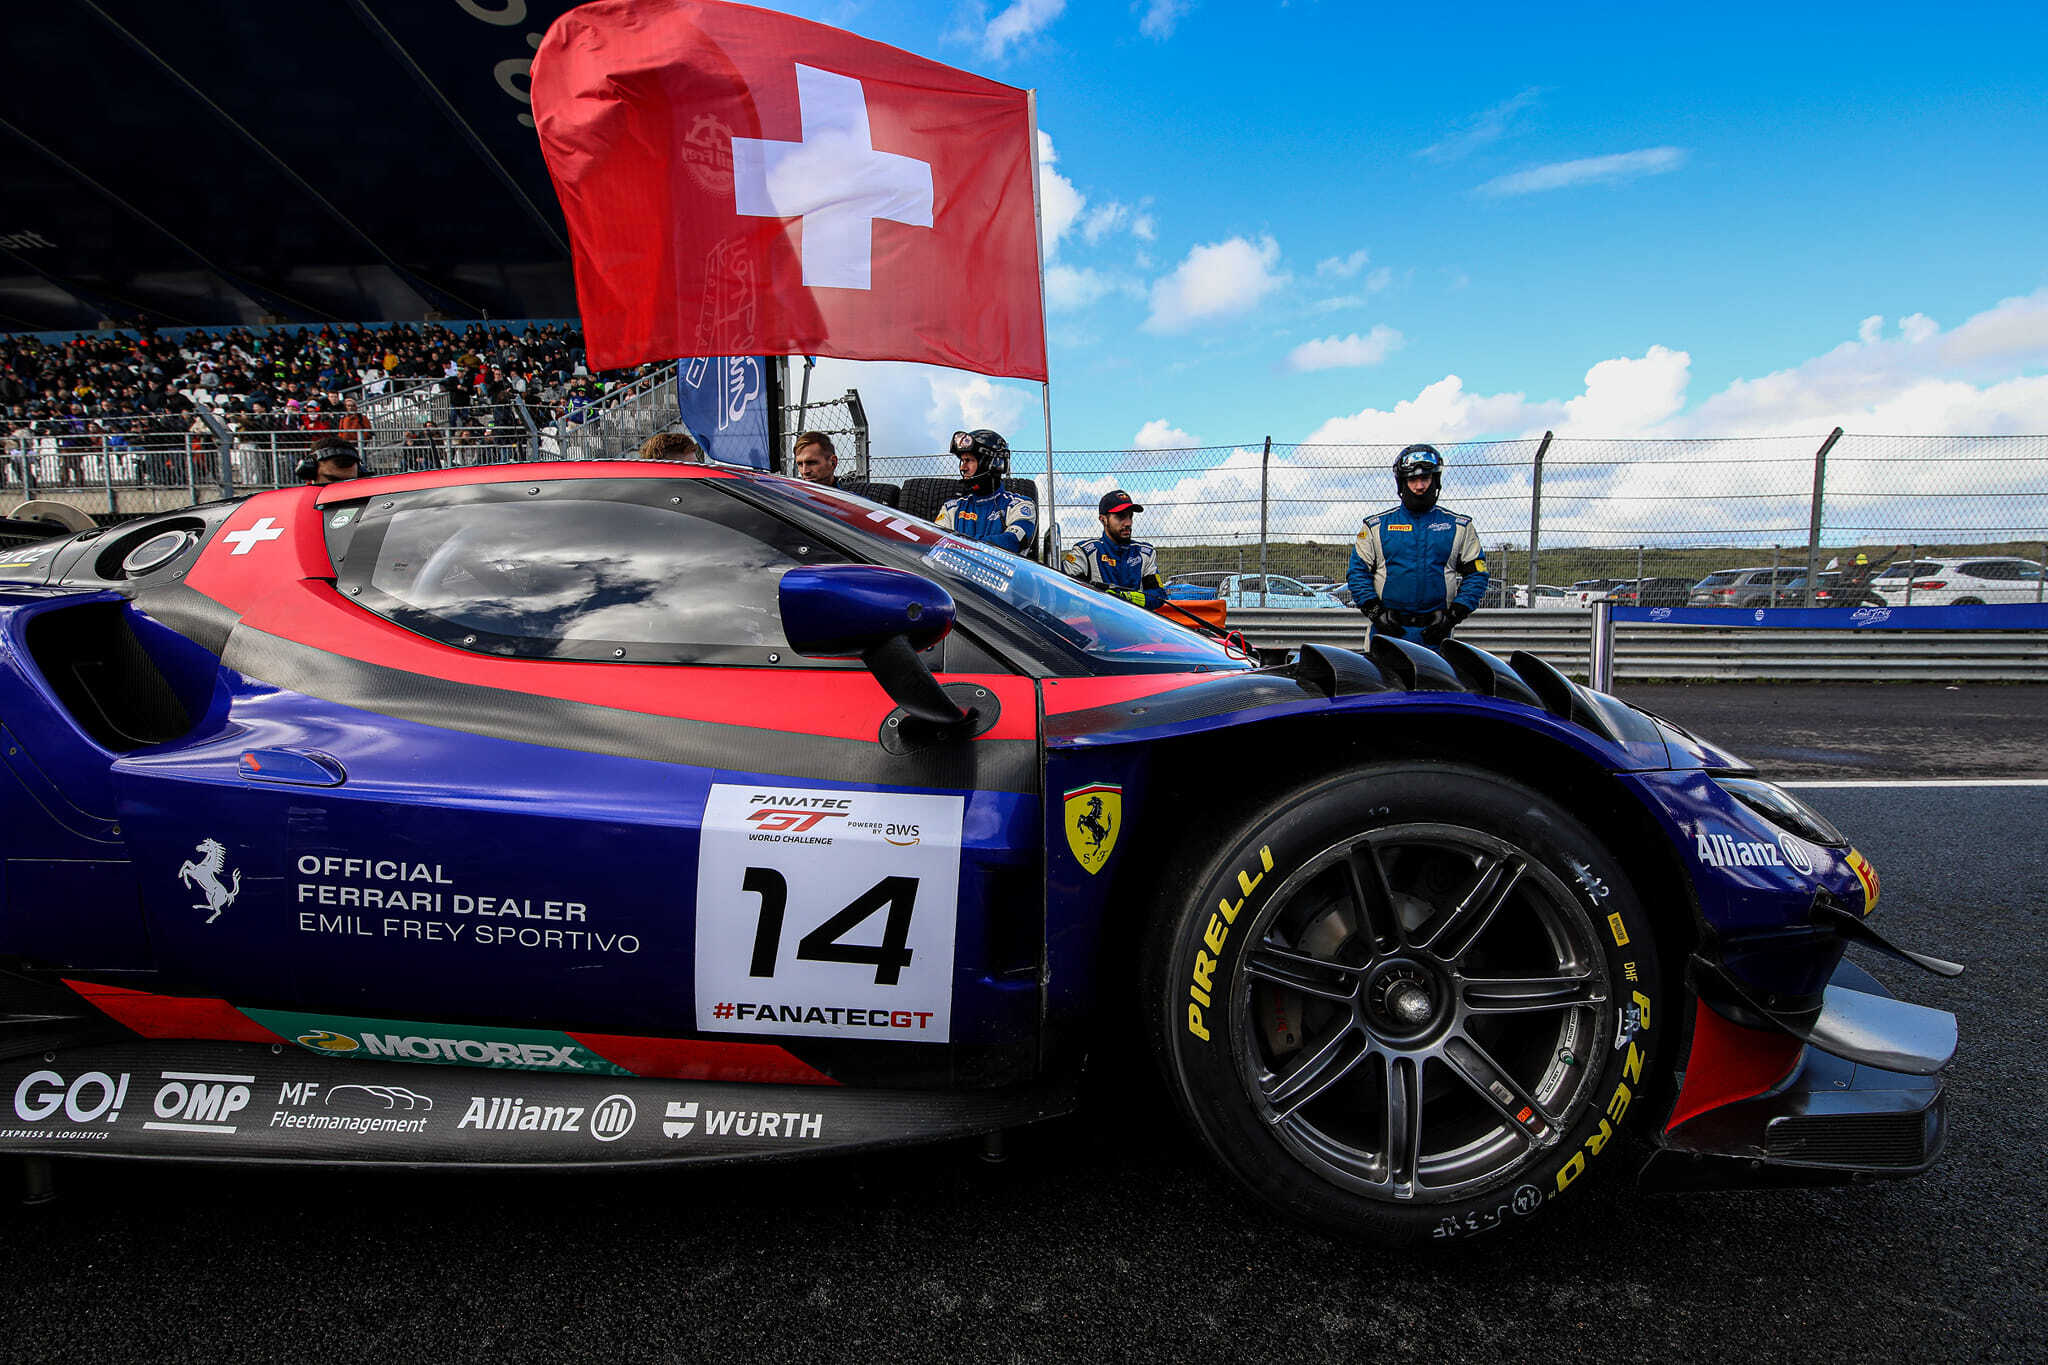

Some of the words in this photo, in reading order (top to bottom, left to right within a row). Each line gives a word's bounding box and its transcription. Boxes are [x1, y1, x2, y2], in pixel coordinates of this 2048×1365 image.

[750, 795, 852, 809] FANATEC
[745, 809, 849, 832] GT
[848, 821, 883, 829] POWERED
[886, 823, 920, 837] aws
[749, 833, 781, 843] WORLD
[783, 835, 833, 846] CHALLENGE
[1695, 834, 1785, 867] Allianz
[297, 855, 453, 884] OFFICIAL
[298, 884, 442, 912] FERRARI
[453, 895, 587, 922] DEALER
[300, 912, 373, 936] EMIL
[384, 919, 465, 942] FREY
[475, 925, 640, 953] SPORTIVO
[742, 867, 920, 985] 14
[1188, 845, 1274, 1041] PIRELLI
[1623, 961, 1639, 983] DHF
[713, 1002, 934, 1028] #FANATECGT
[1632, 990, 1651, 1030] P
[360, 1032, 584, 1068] MOTOREX
[14, 1070, 131, 1122] GO!
[153, 1081, 251, 1122] OMP
[278, 1082, 319, 1106] MF
[270, 1111, 427, 1134] Fleetmanagement
[457, 1096, 585, 1132] Allianz
[704, 1110, 823, 1139] WÜRTH
[1556, 1041, 1646, 1192] ZERO
[0, 1129, 44, 1139] EXPRESS
[46, 1131, 53, 1139] &
[56, 1130, 110, 1141] LOGISTICS
